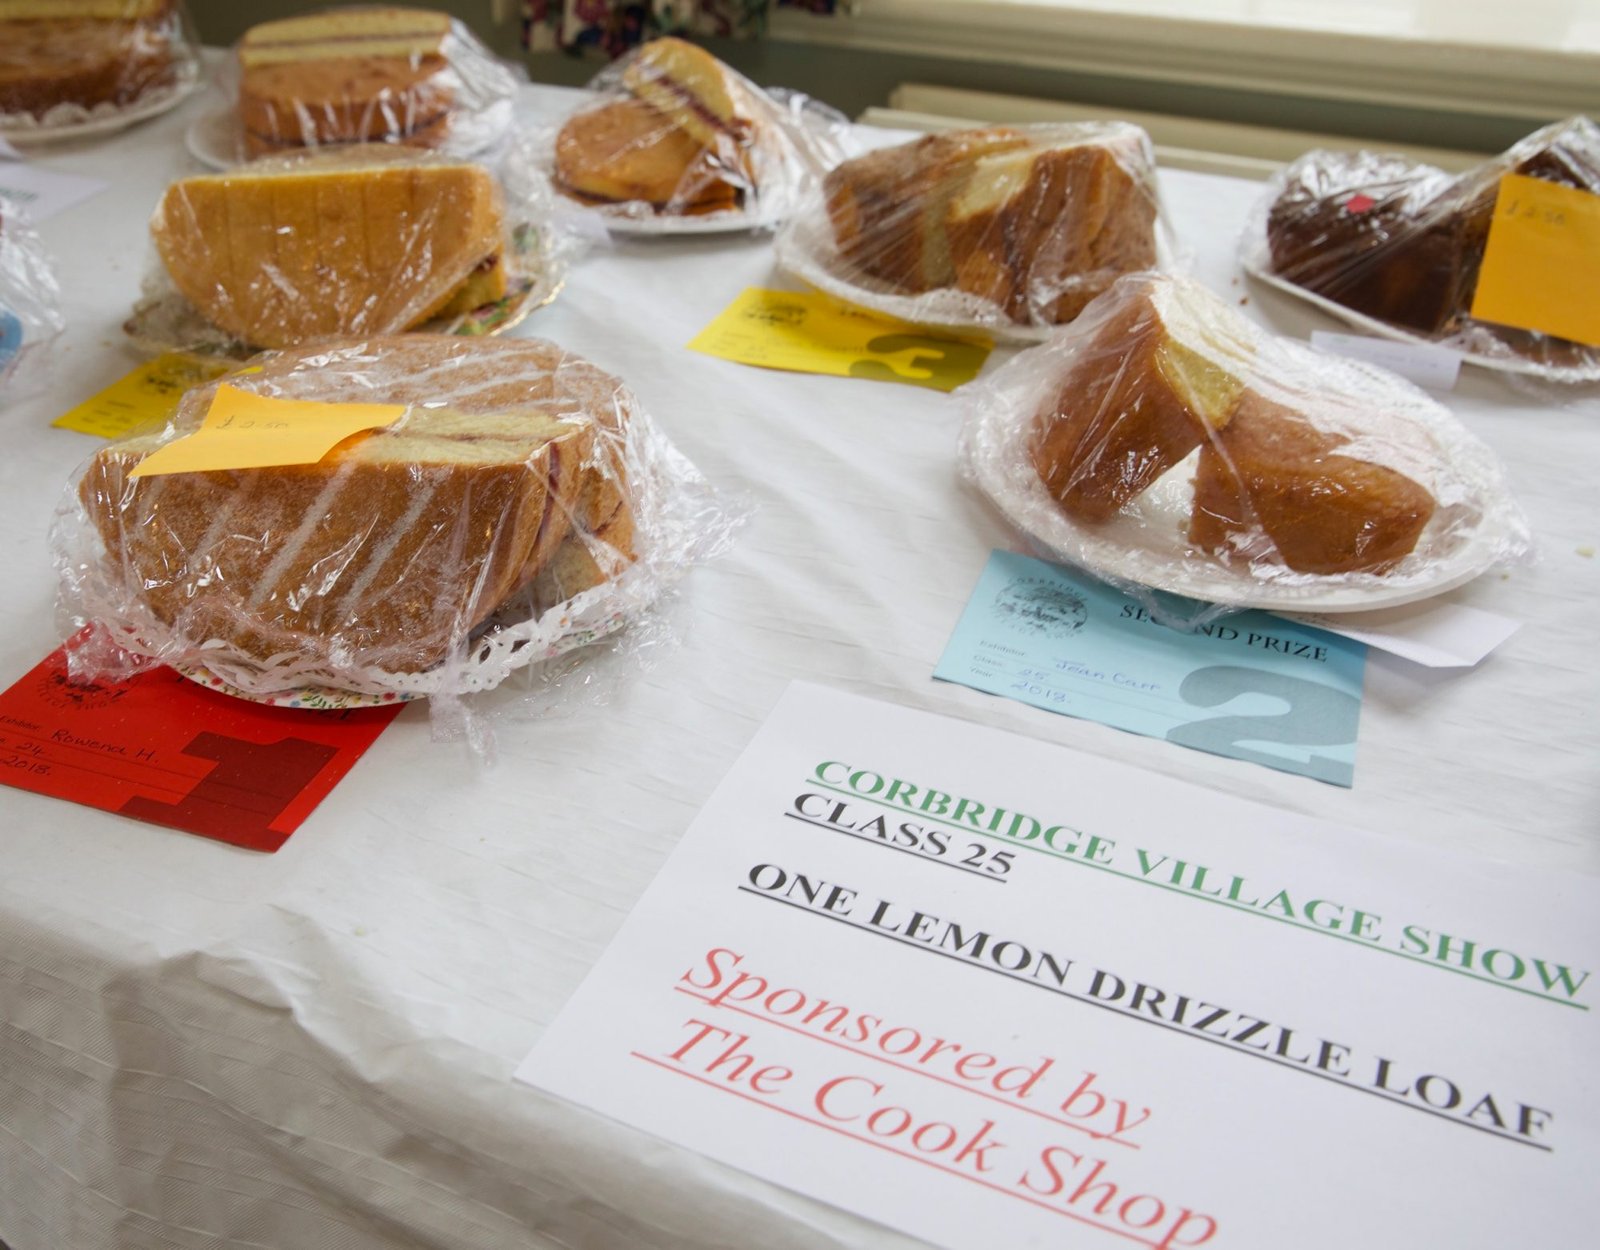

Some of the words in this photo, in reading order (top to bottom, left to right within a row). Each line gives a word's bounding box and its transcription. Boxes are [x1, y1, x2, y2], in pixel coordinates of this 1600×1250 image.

[1054, 658, 1105, 681] Jean
[1112, 671, 1161, 692] Carr
[1120, 604, 1239, 641] SEND
[1247, 632, 1329, 663] PRIZE
[51, 729, 127, 757] Rowena
[1165, 664, 1362, 788] 2
[793, 792, 953, 856] CLASS
[959, 842, 1018, 875] 25
[814, 760, 1117, 865] CORBRIDGE
[1136, 847, 1382, 942] VILLAGE
[1399, 924, 1591, 998] SHOW
[680, 946, 1056, 1100] Sponsored
[1059, 1071, 1152, 1140] by
[748, 863, 859, 917] ONE
[867, 899, 1075, 988] LEMON
[1086, 969, 1352, 1077] DRIZZLE
[1370, 1055, 1554, 1138] LOAF
[664, 1017, 794, 1095] The
[814, 1074, 1010, 1173] Cook
[1018, 1145, 1218, 1250] Shop
